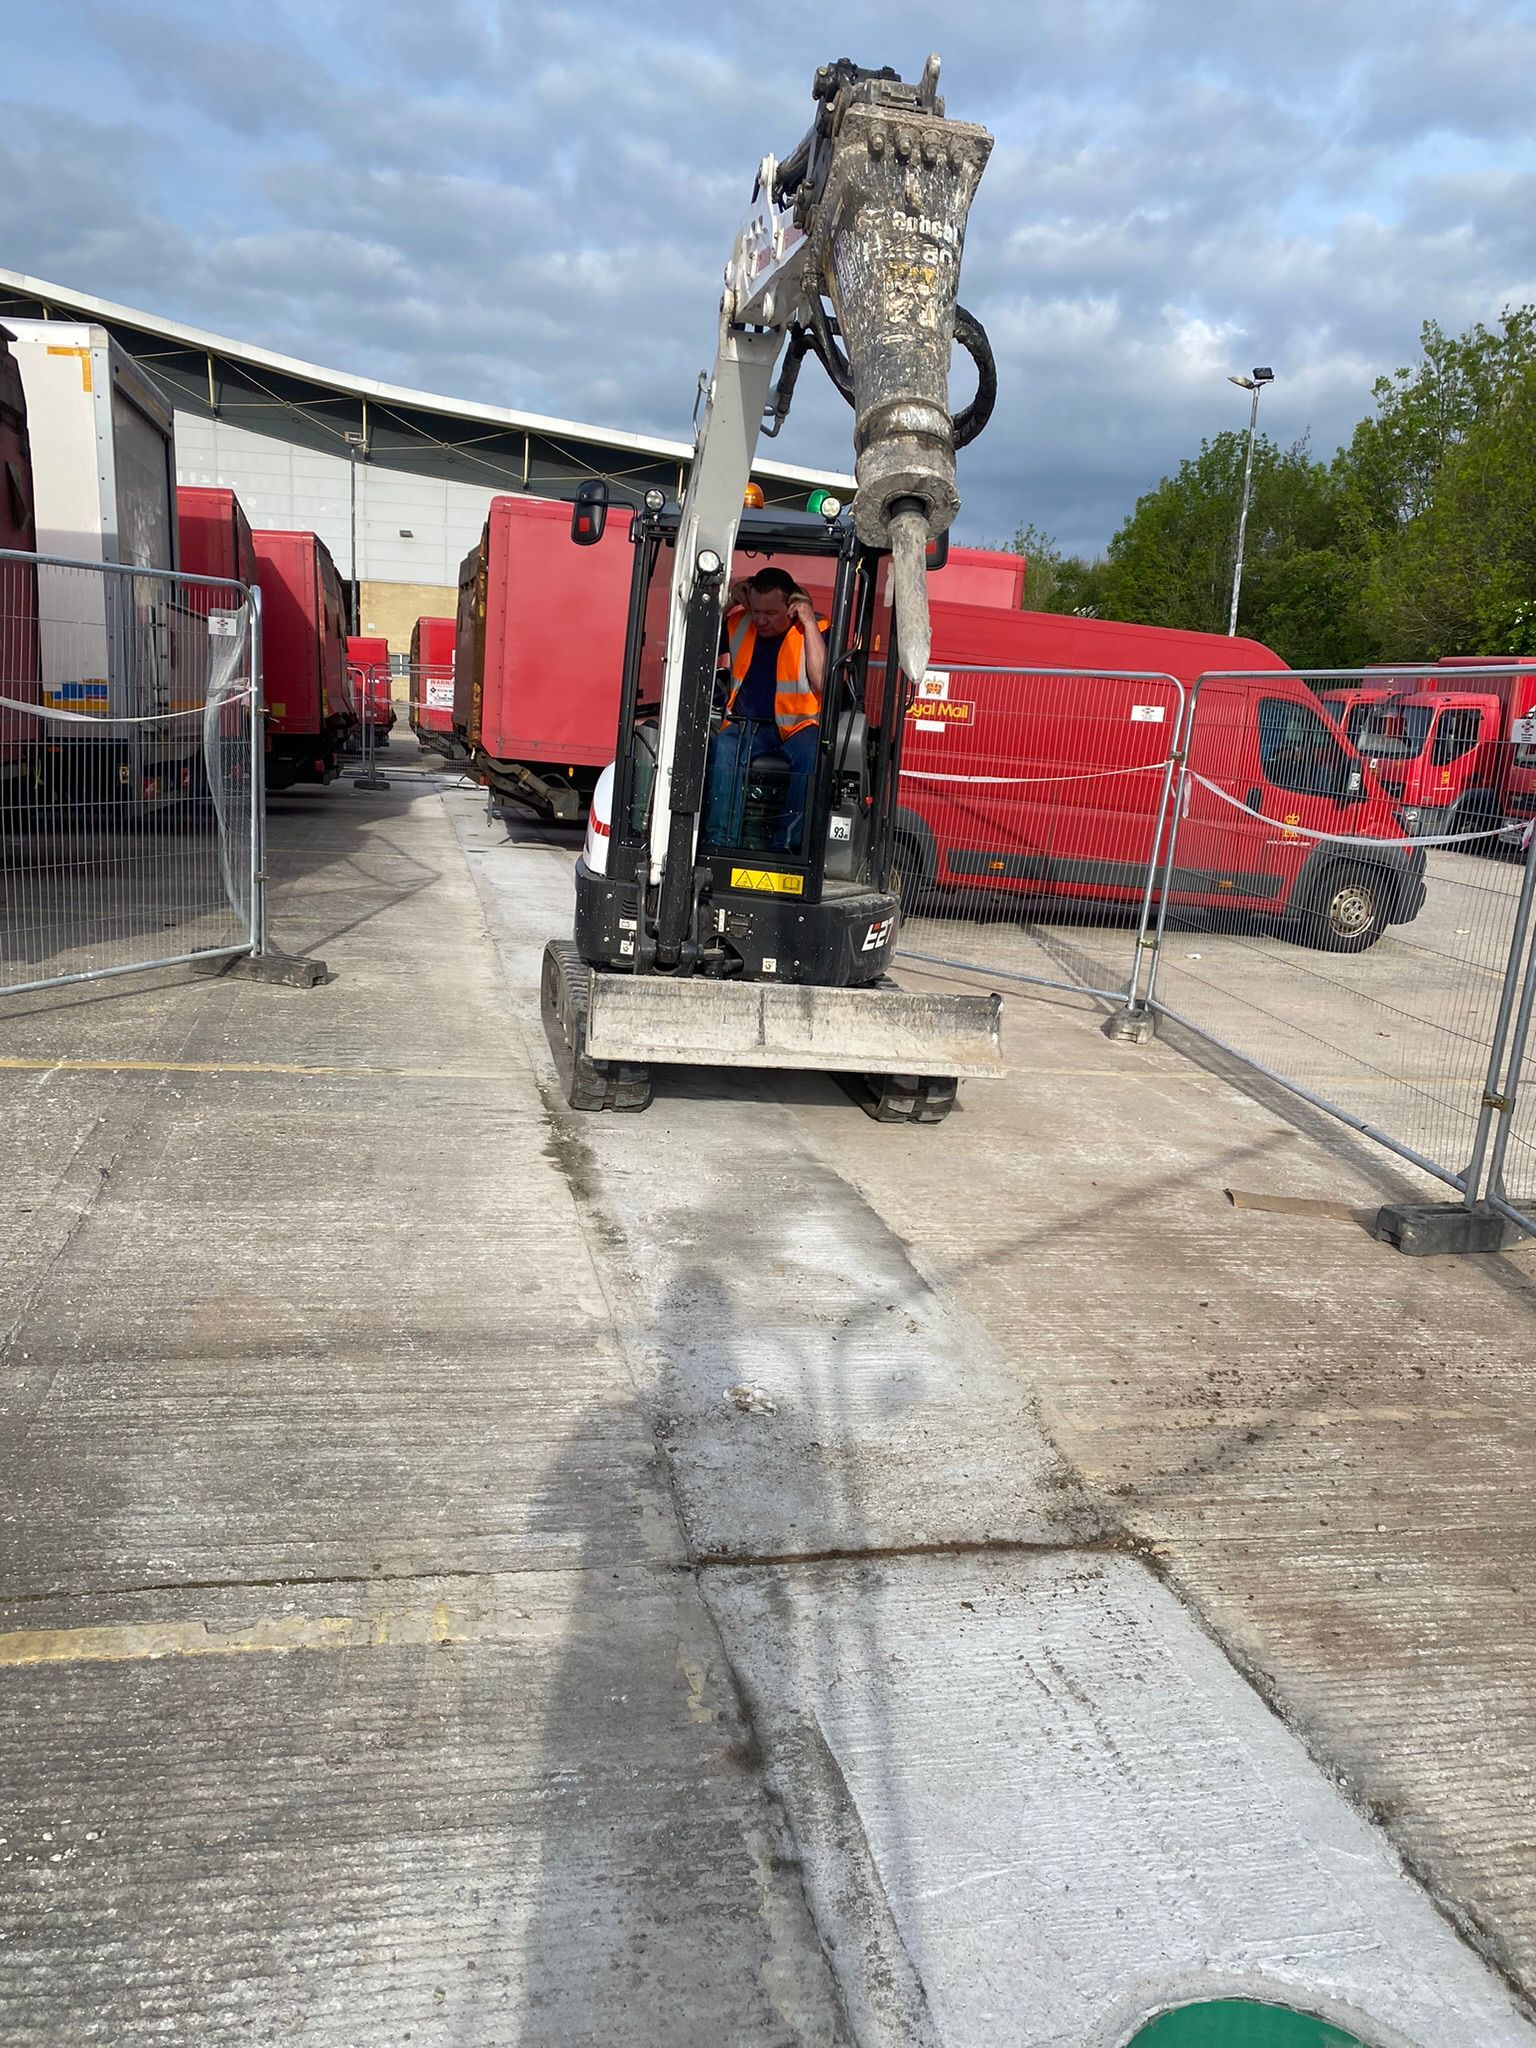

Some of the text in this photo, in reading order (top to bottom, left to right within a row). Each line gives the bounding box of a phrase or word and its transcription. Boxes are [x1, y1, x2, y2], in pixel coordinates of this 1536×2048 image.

[904, 701, 968, 718] oyal Mail
[834, 826, 844, 838] 93
[861, 916, 895, 951] E27
